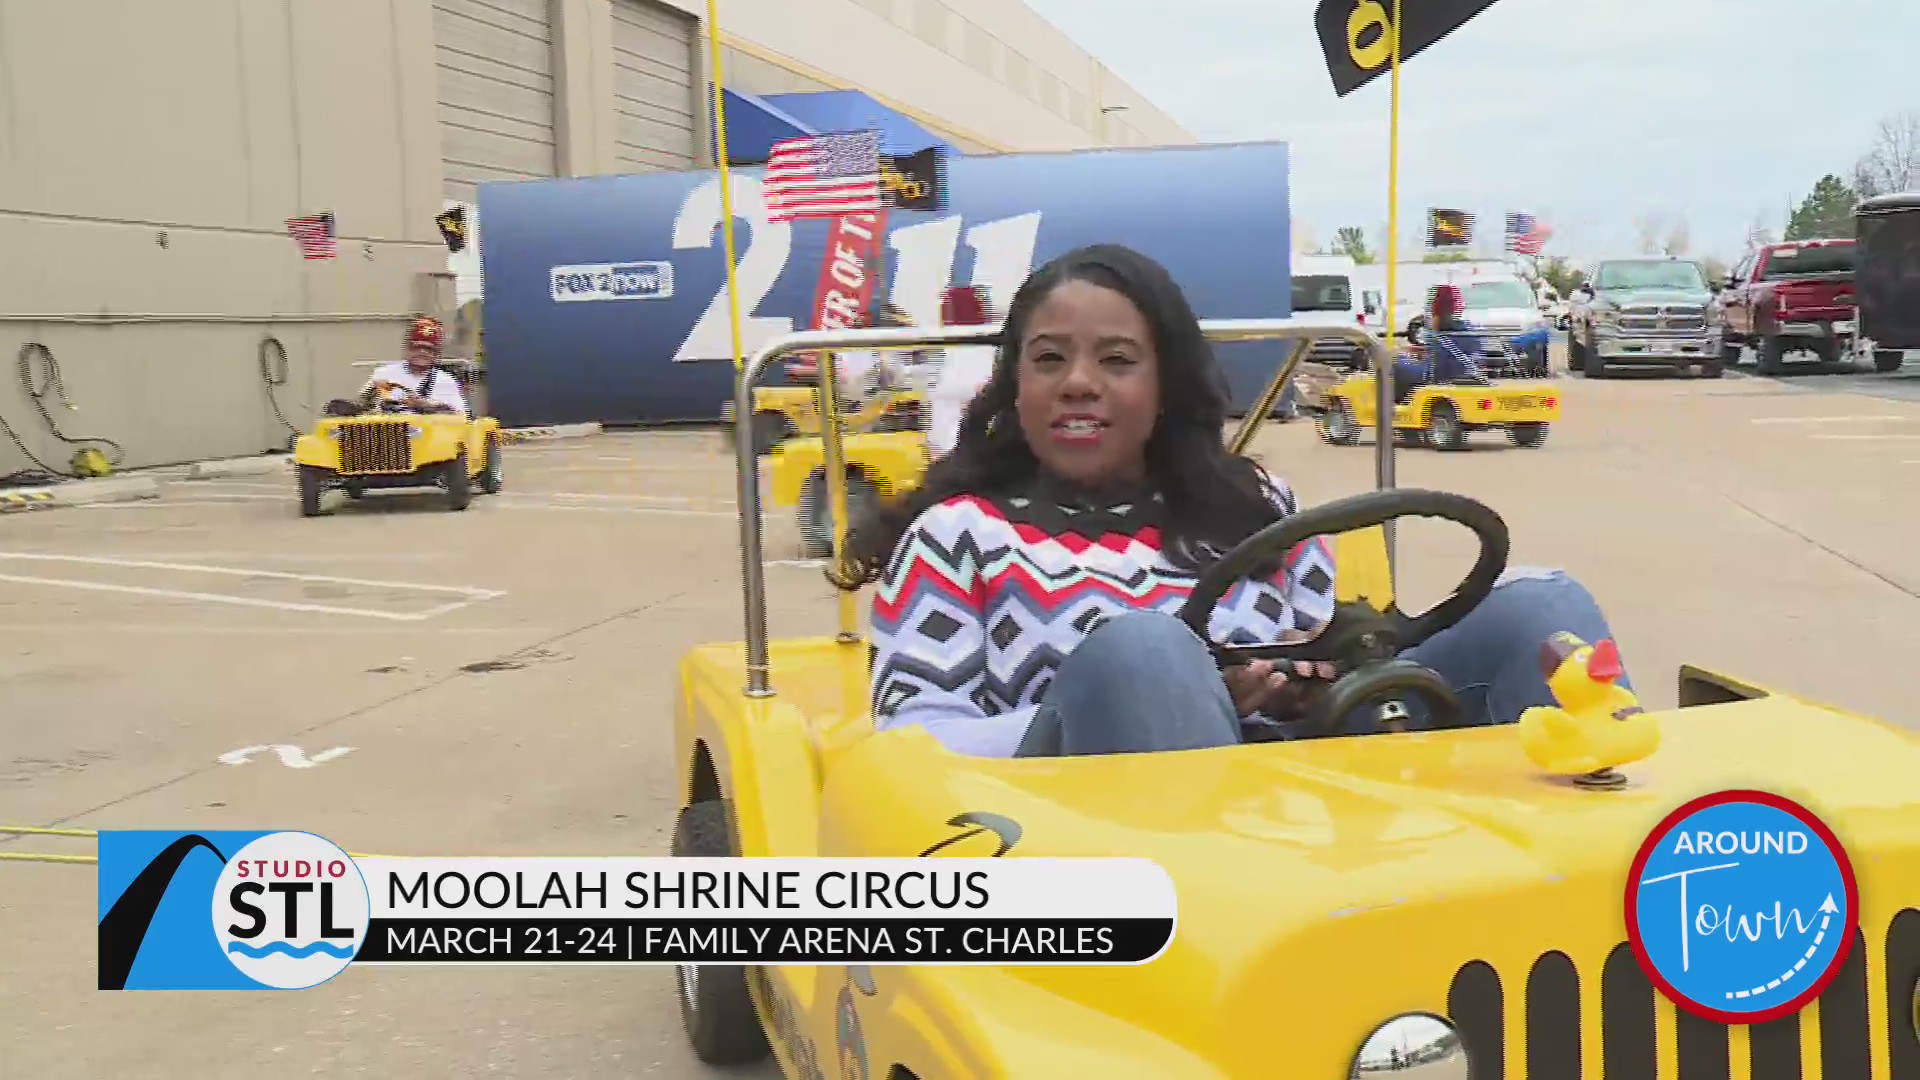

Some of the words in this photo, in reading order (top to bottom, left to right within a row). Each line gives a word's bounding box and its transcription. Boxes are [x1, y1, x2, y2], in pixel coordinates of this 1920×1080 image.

[556, 272, 596, 294] FOX
[598, 272, 612, 292] 2
[613, 272, 661, 292] now
[672, 174, 793, 363] 2
[830, 241, 865, 289] OF
[888, 210, 1043, 345] 11
